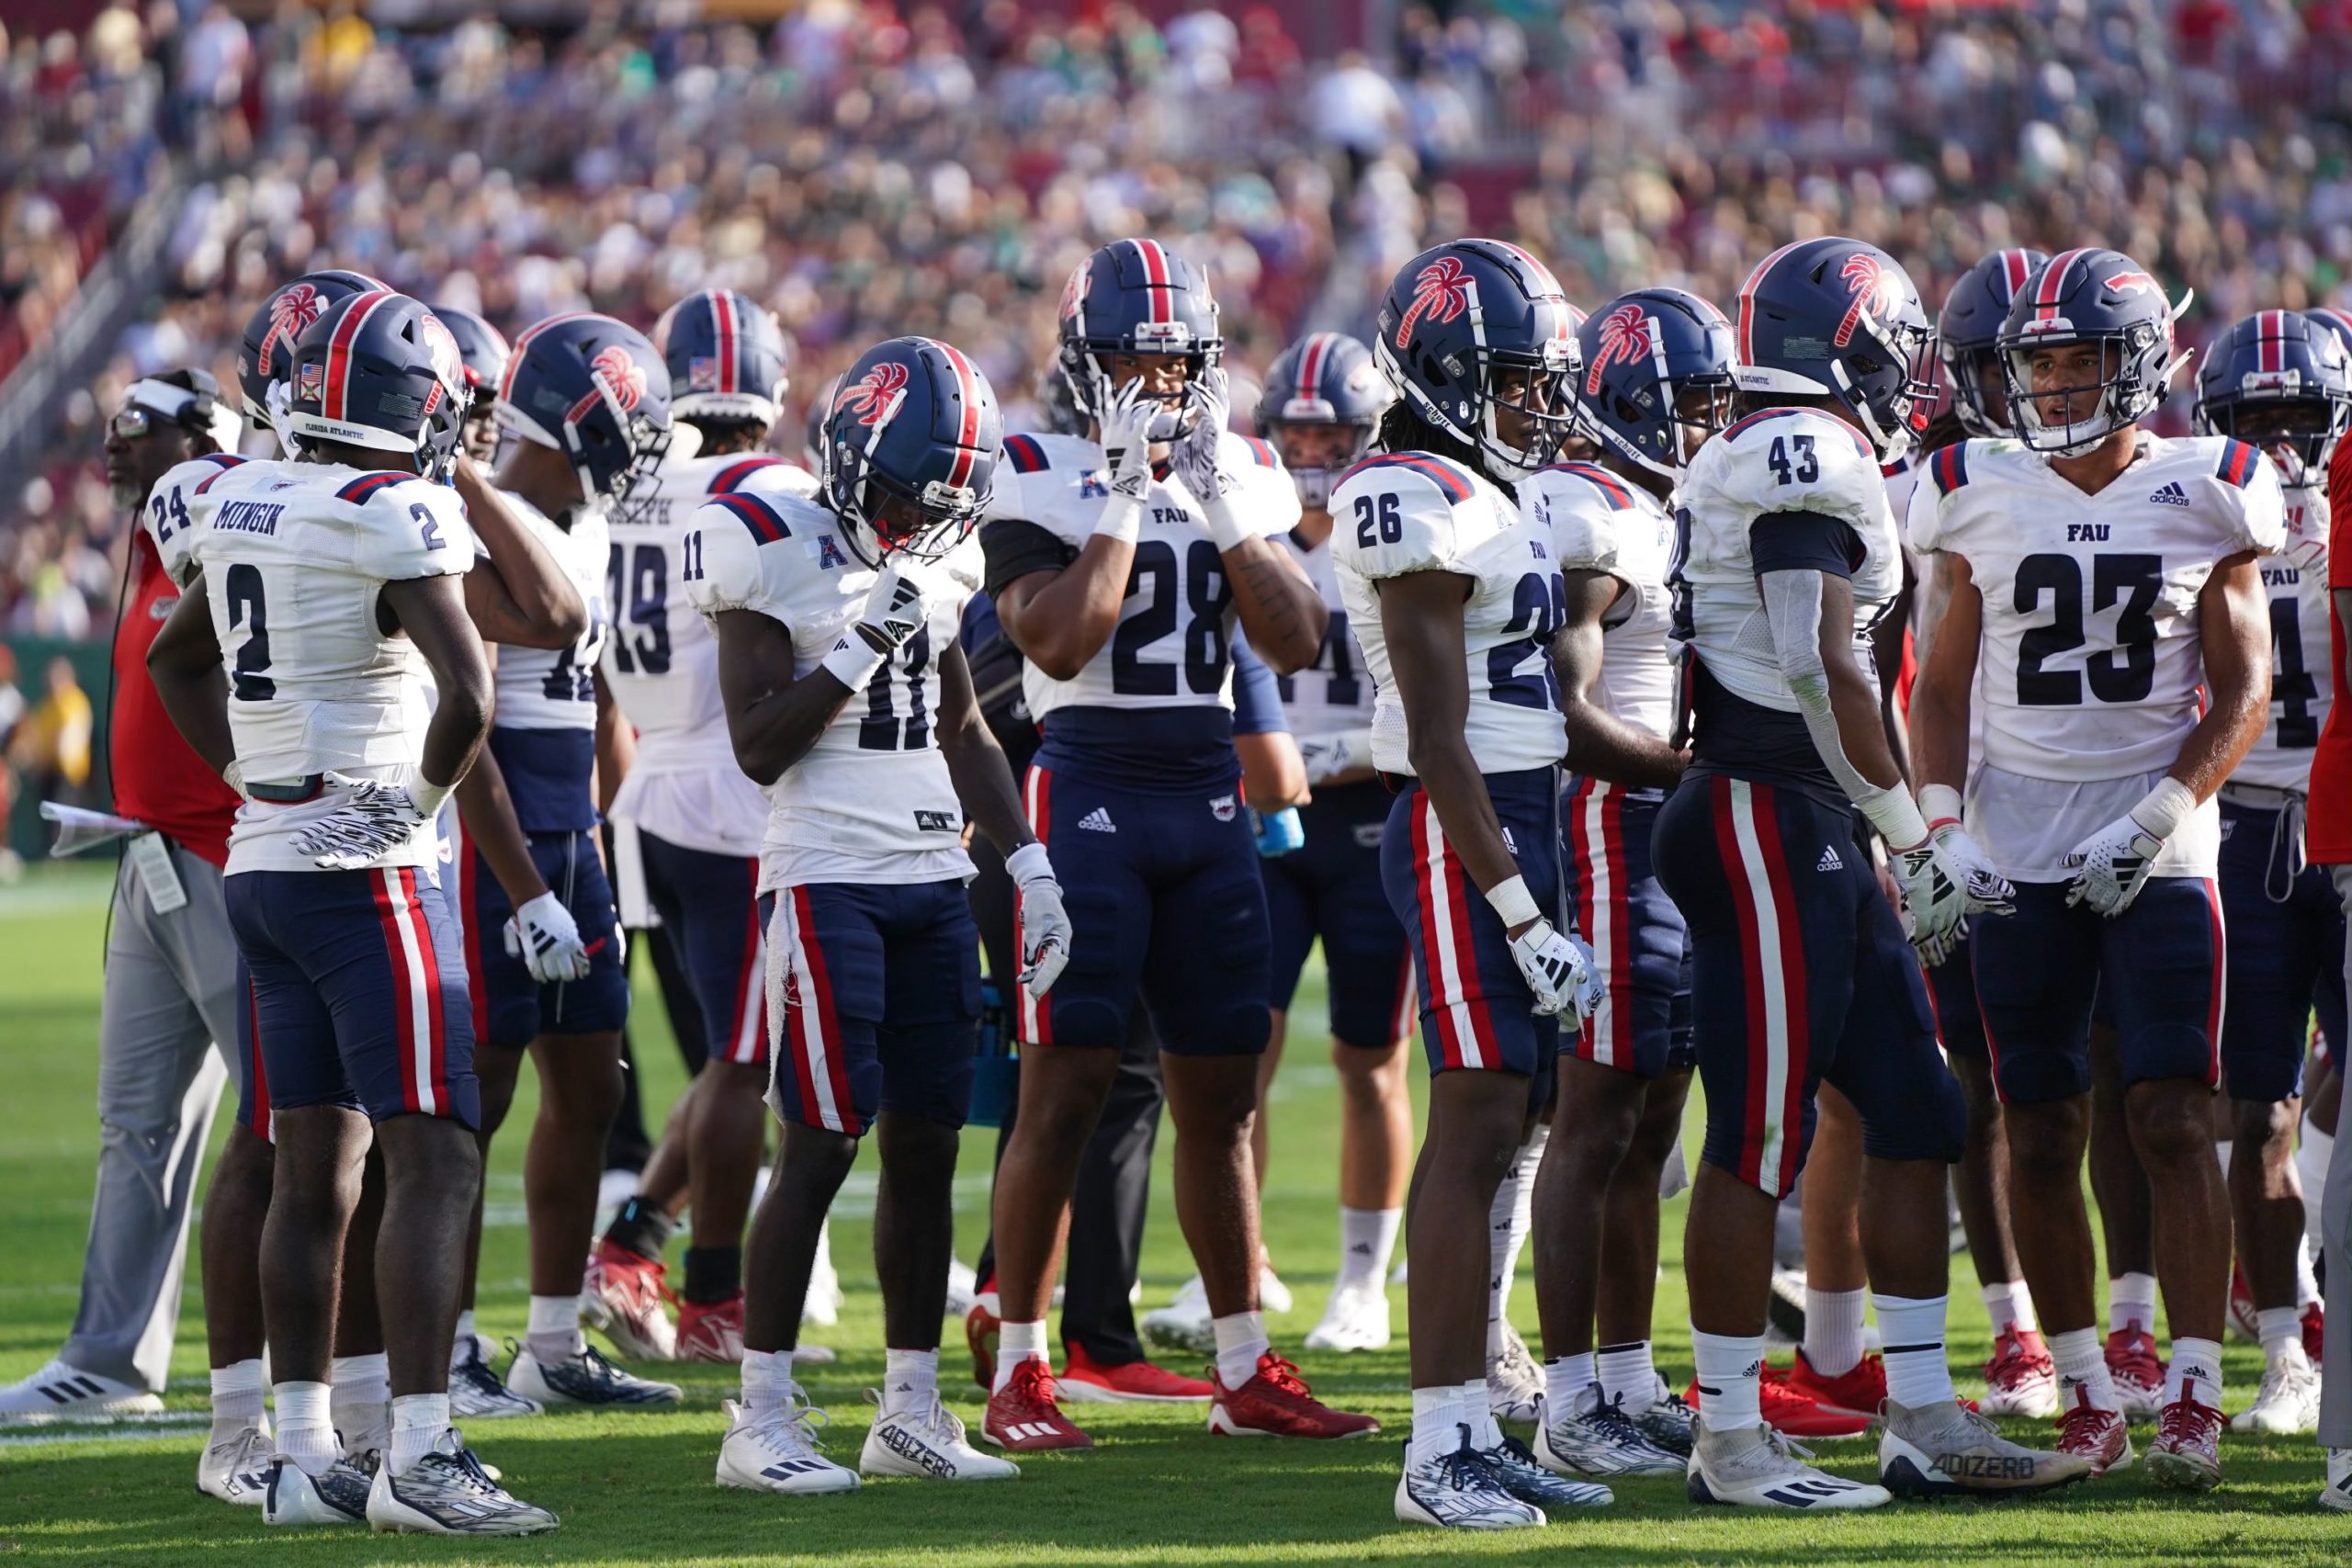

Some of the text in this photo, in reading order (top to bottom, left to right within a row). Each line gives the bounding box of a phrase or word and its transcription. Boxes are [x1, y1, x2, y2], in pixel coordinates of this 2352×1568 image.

[305, 423, 365, 440] FLORIDA ATLANTIC
[1424, 401, 1451, 428] schutt
[1613, 436, 1642, 459] schutt
[1769, 435, 1818, 485] 43
[152, 484, 191, 545] 24
[213, 500, 286, 536] MUNGIN
[1152, 508, 1189, 524] FAU
[2150, 494, 2189, 506] adidas
[410, 503, 446, 551] 2
[1355, 492, 1402, 549] 26
[2067, 525, 2110, 542] FAU
[684, 530, 704, 581] 11
[227, 564, 276, 701] 2
[1112, 540, 1232, 695] 28
[2014, 553, 2163, 705] 23
[859, 621, 929, 750] 11
[1078, 820, 1116, 833] adidas
[1817, 860, 1843, 872] adidas
[1928, 1452, 2035, 1480] ADIZERO
